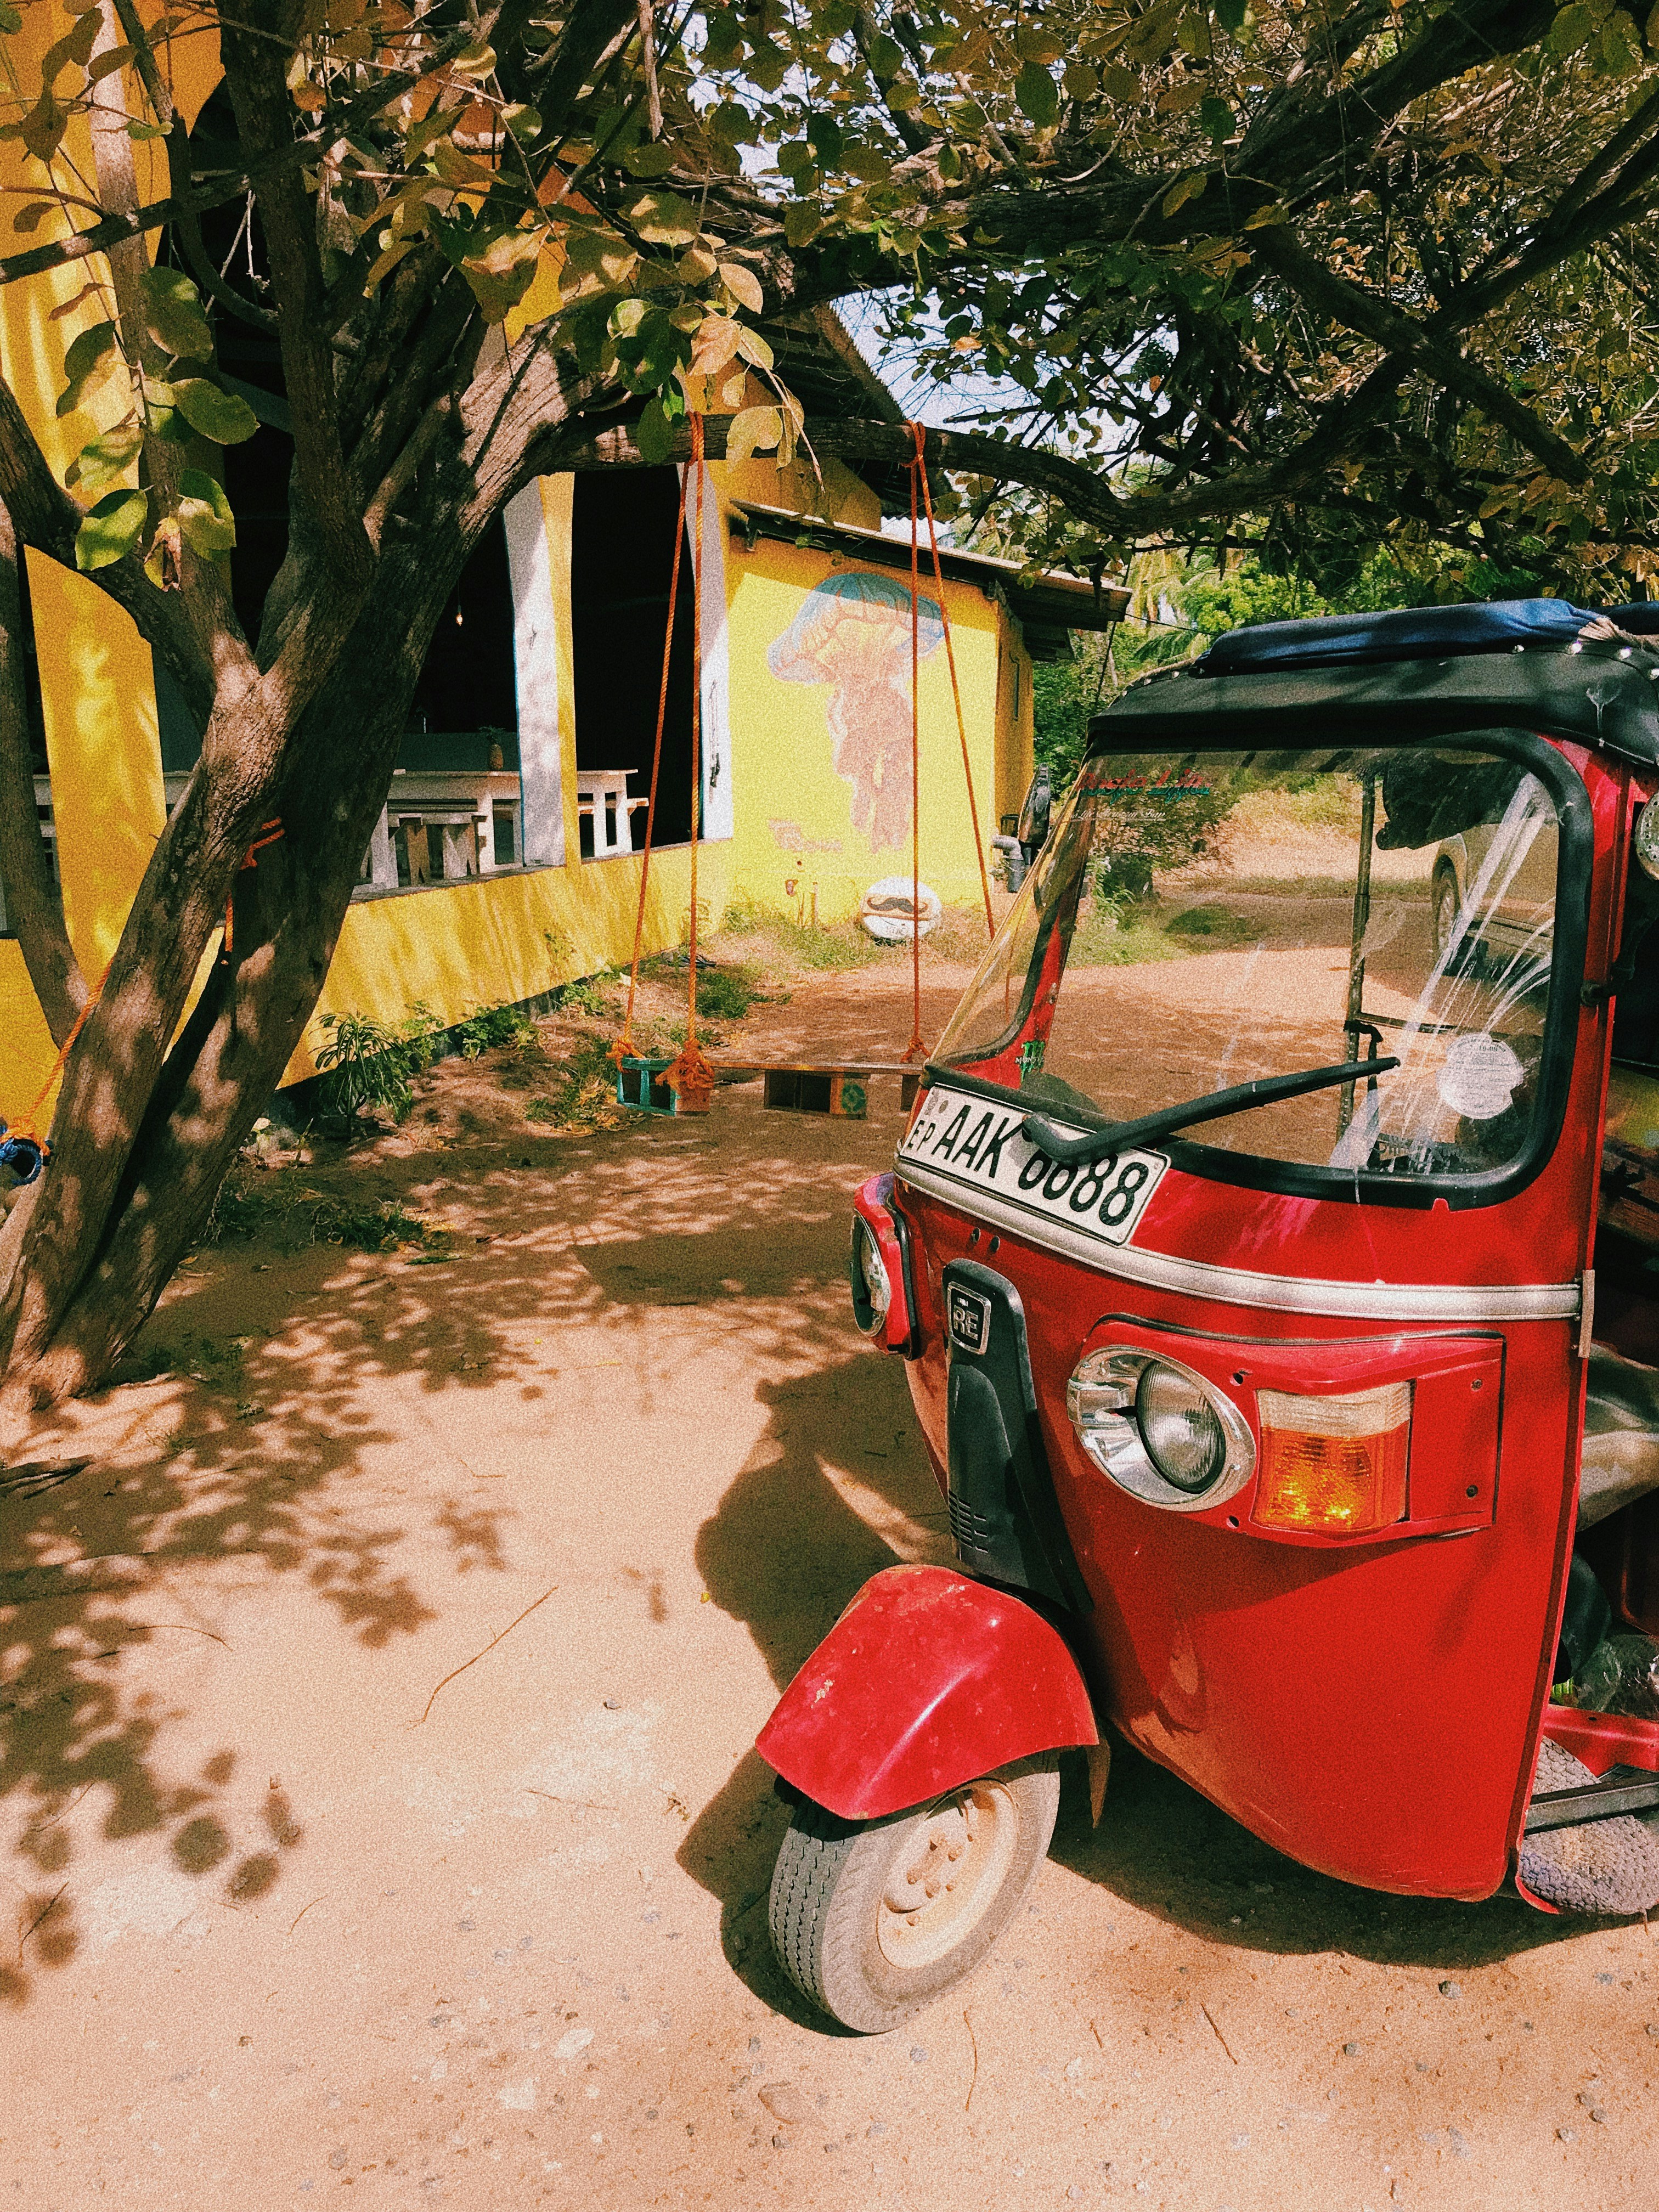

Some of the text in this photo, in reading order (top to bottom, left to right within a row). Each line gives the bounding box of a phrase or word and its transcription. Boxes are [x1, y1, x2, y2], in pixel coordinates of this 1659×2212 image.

[907, 1120, 936, 1152] EP
[931, 1104, 1024, 1179] AAK
[953, 1305, 978, 1340] RE
